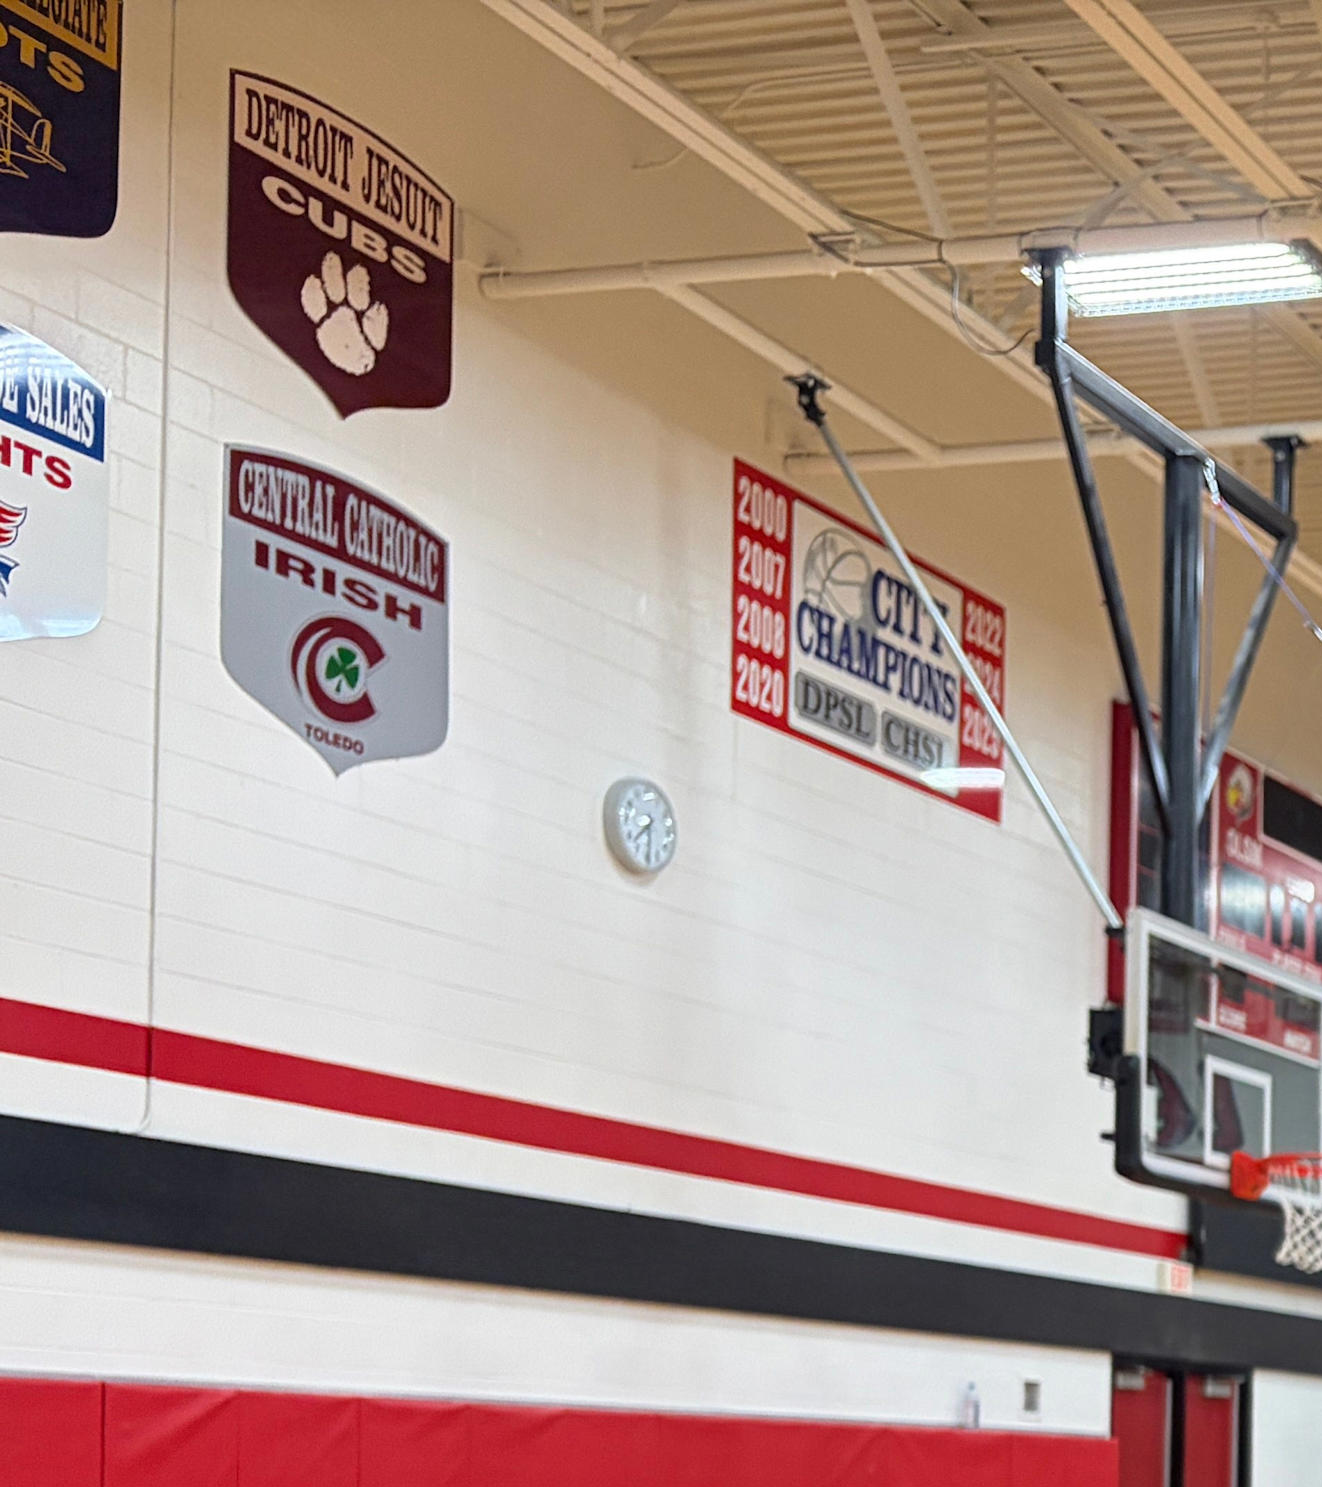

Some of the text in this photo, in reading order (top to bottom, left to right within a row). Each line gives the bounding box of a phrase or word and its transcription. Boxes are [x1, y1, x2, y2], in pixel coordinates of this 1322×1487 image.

[245, 87, 446, 247] DETROIT JESUIT
[261, 175, 428, 284] CUBS
[26, 366, 95, 448] SALES
[238, 459, 440, 594] CENTRAL CATHOLIC
[738, 475, 787, 543] 2000
[254, 541, 424, 631] IRISH
[738, 535, 786, 600] 2007
[735, 653, 785, 718] 2020
[796, 600, 957, 724] CHAMPIONS
[304, 722, 364, 756] TOLEDO
[802, 679, 872, 738] DPSL
